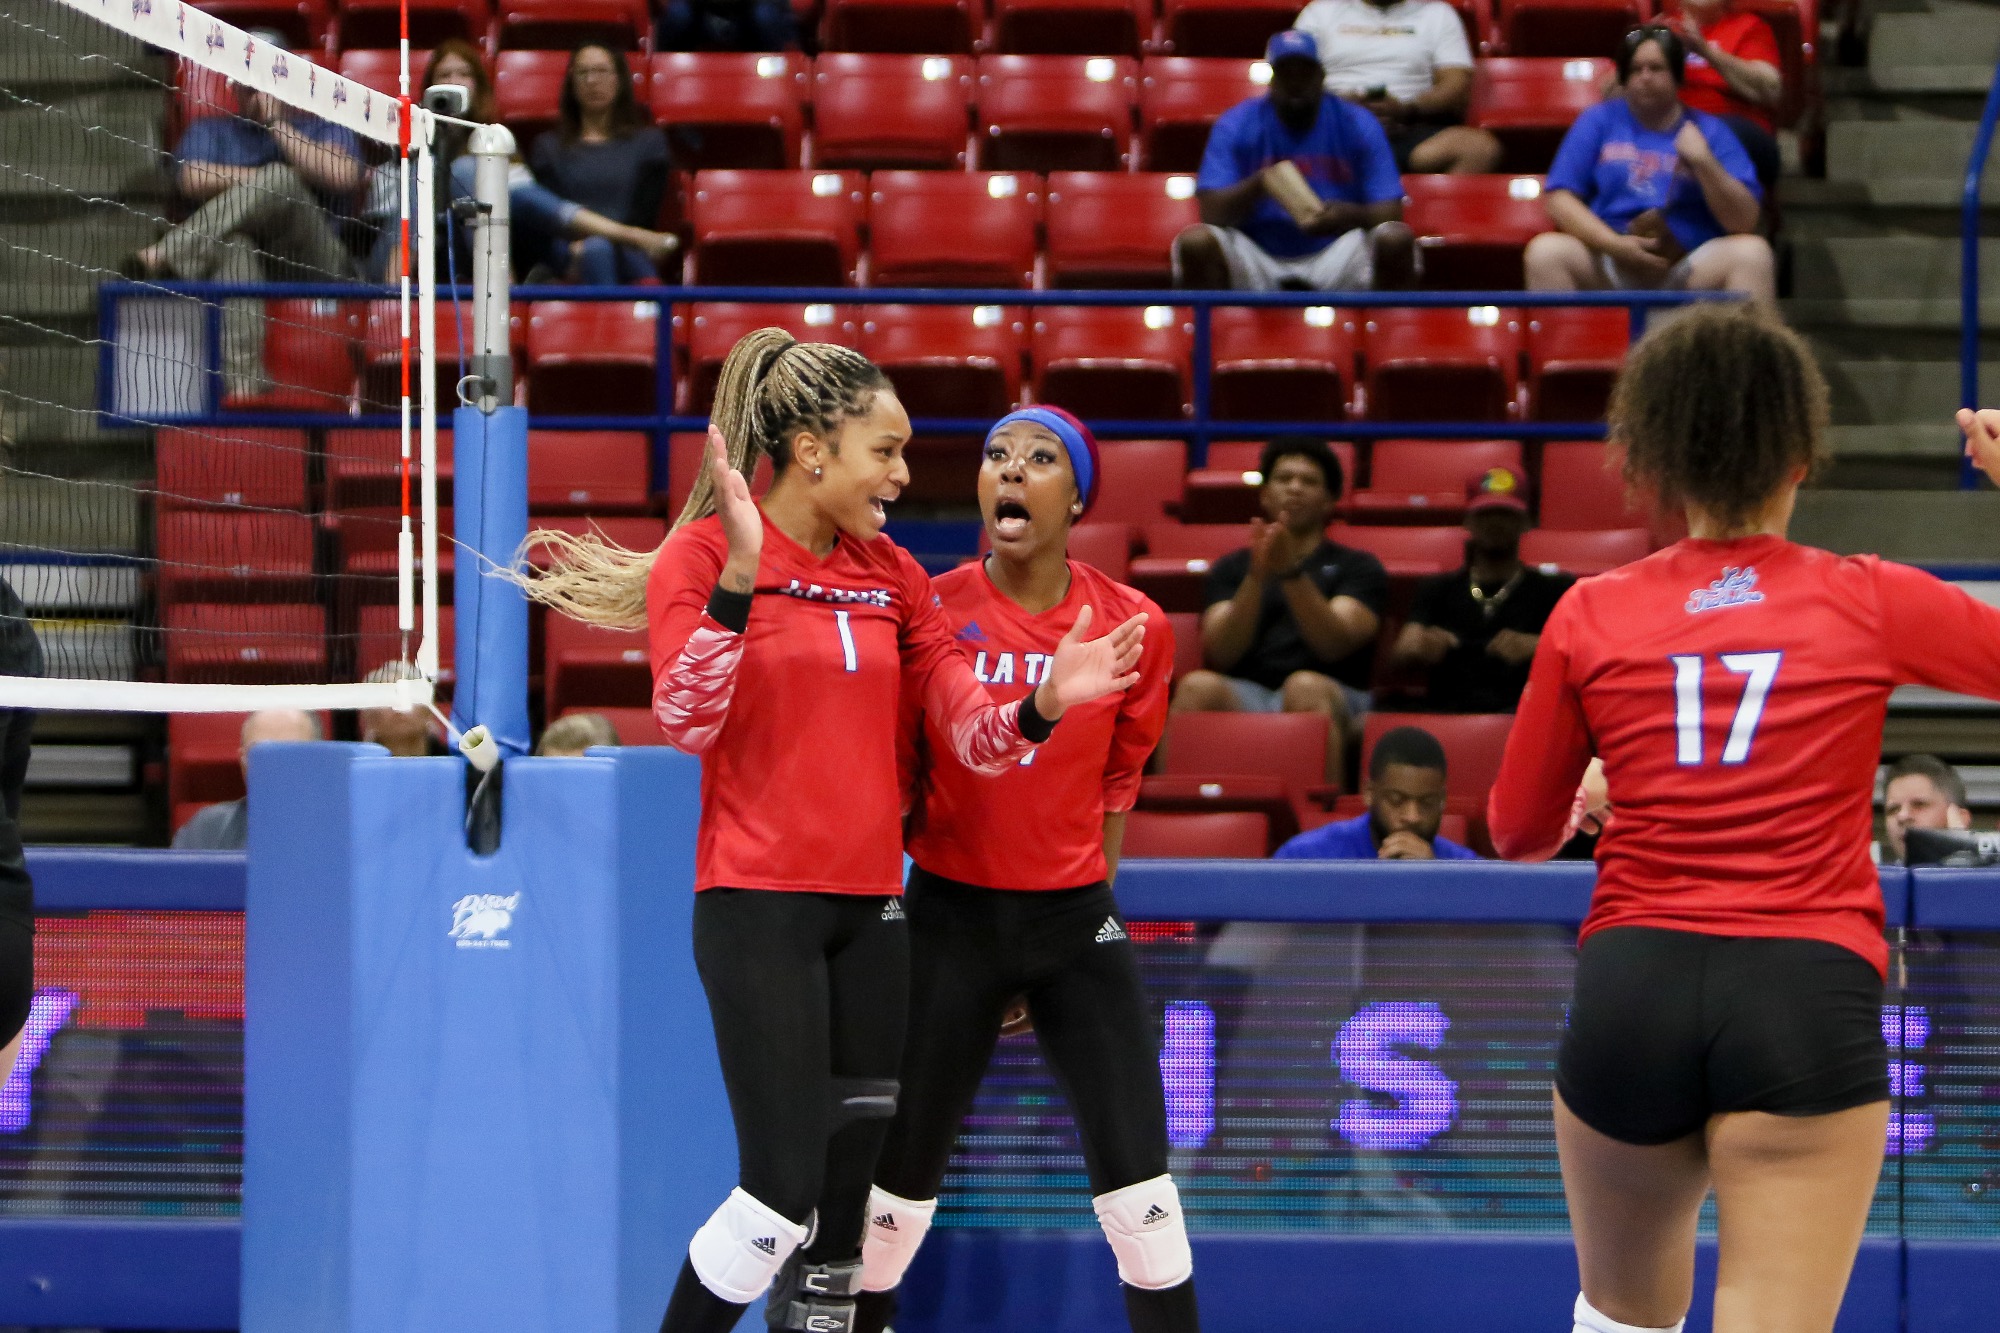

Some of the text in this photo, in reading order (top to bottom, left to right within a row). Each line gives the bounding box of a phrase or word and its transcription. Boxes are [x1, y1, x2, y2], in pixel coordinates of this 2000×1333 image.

[833, 609, 858, 672] 1
[974, 651, 1014, 684] LA
[1669, 650, 1784, 767] 17
[881, 909, 905, 921] adidas
[1095, 930, 1127, 943] adidas
[872, 1218, 898, 1232] adidas
[1142, 1211, 1169, 1225] adidas
